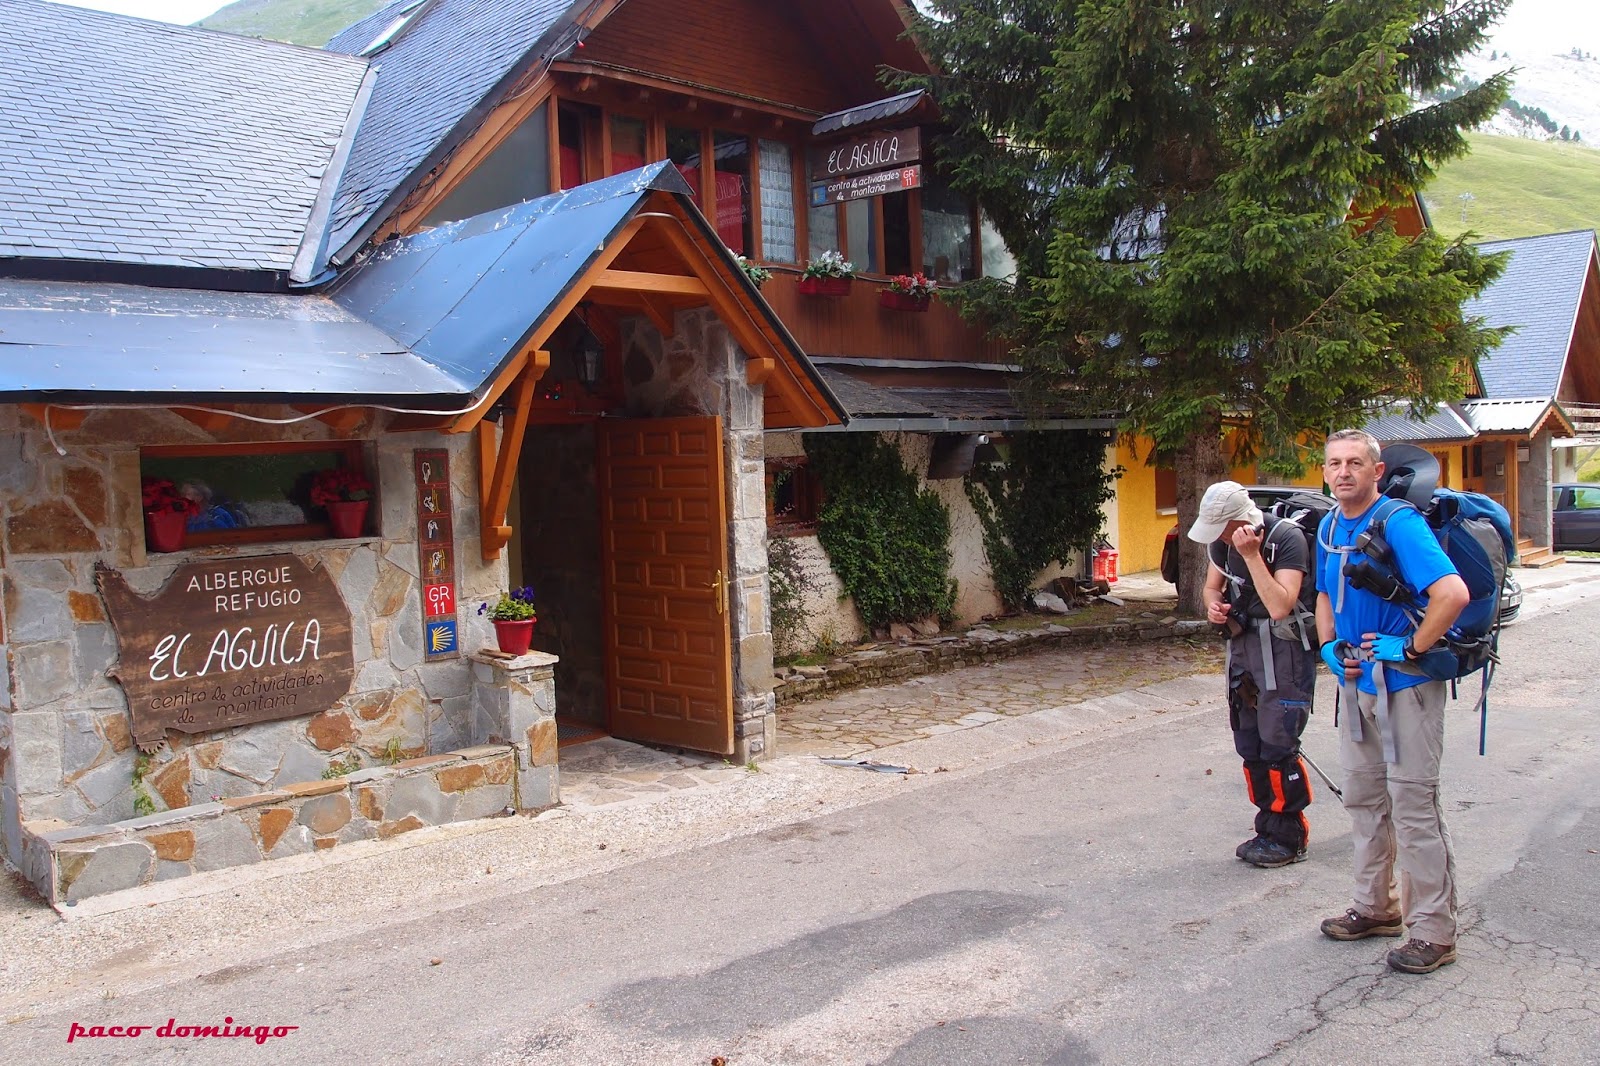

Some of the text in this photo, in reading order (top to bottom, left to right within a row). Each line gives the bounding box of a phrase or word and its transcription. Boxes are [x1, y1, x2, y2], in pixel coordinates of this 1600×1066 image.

[827, 136, 899, 173] EL AGUILA
[828, 181, 850, 193] centro
[858, 171, 900, 186] actividades
[903, 170, 914, 179] GR
[905, 178, 912, 186] 11
[851, 183, 886, 197] montaña
[186, 566, 292, 592] ALBERGUE
[215, 589, 301, 613] REFUGIO
[428, 585, 450, 602] GR
[433, 601, 446, 615] 11
[149, 618, 320, 681] EL AGUILA
[151, 669, 324, 710] centro de actividades
[177, 692, 298, 724] de montaña
